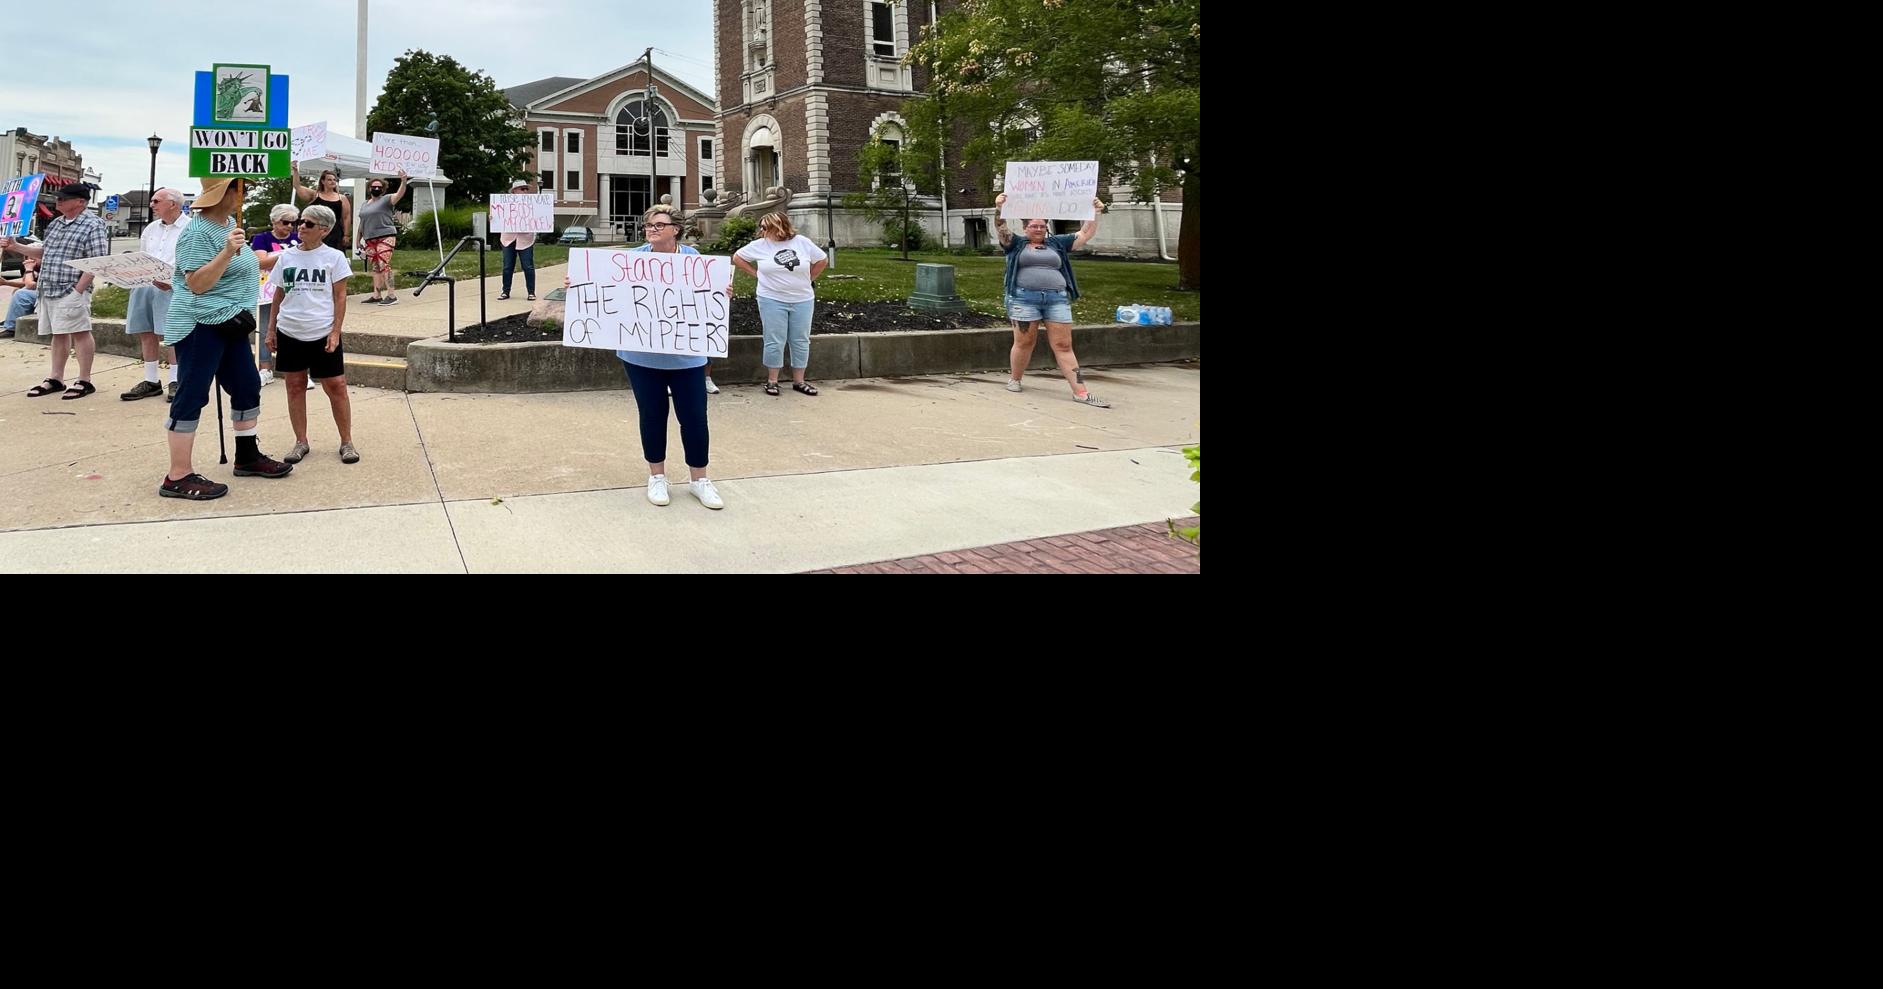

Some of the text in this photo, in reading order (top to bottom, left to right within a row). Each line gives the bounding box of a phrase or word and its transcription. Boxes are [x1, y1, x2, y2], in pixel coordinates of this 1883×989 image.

[195, 130, 257, 147] WON'T
[263, 132, 287, 149] GO
[375, 145, 430, 162] 400000
[211, 154, 266, 173] BACK
[1018, 163, 1096, 177] MAYBE SOMEDAY
[1008, 180, 1045, 191] WOMEN
[585, 250, 590, 281] I
[683, 256, 716, 289] for
[570, 282, 726, 320] THE RIGHTS
[658, 320, 728, 354] PEERS
